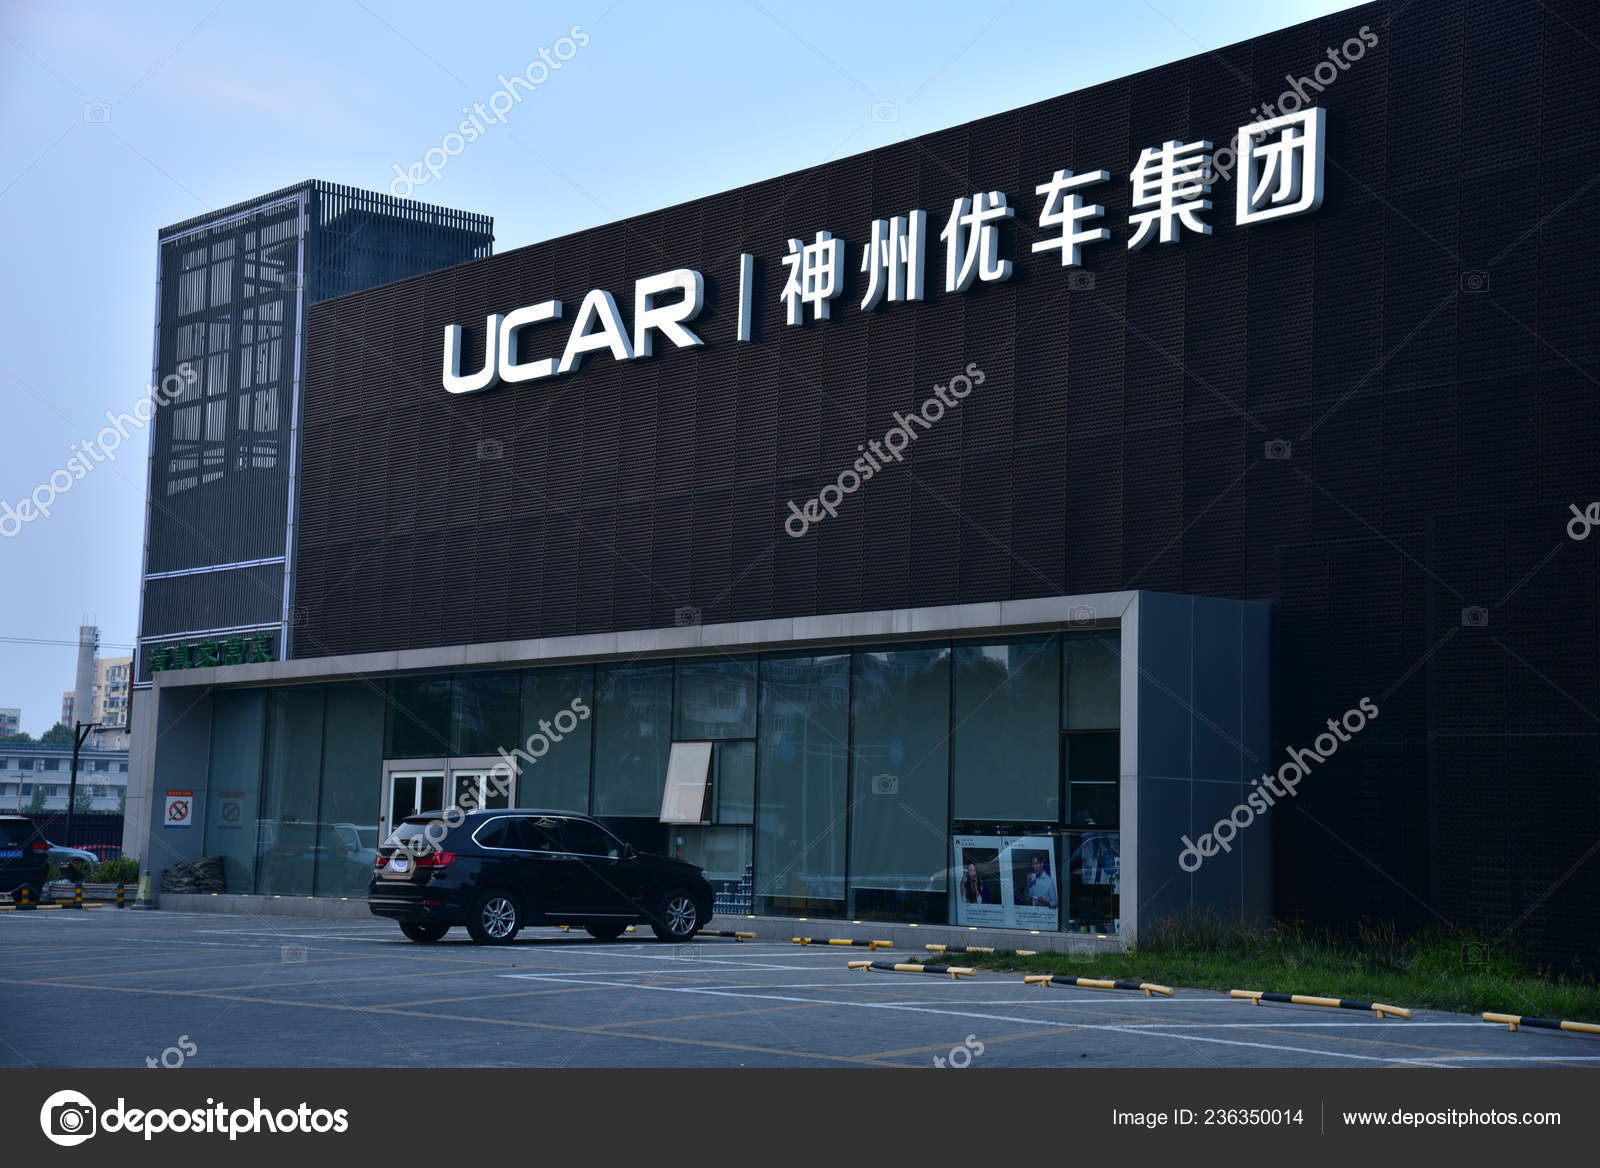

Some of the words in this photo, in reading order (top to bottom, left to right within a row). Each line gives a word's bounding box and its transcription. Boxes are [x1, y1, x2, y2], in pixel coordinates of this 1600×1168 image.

[780, 106, 1326, 326] 神州优车集团
[443, 268, 704, 394] UCAR
